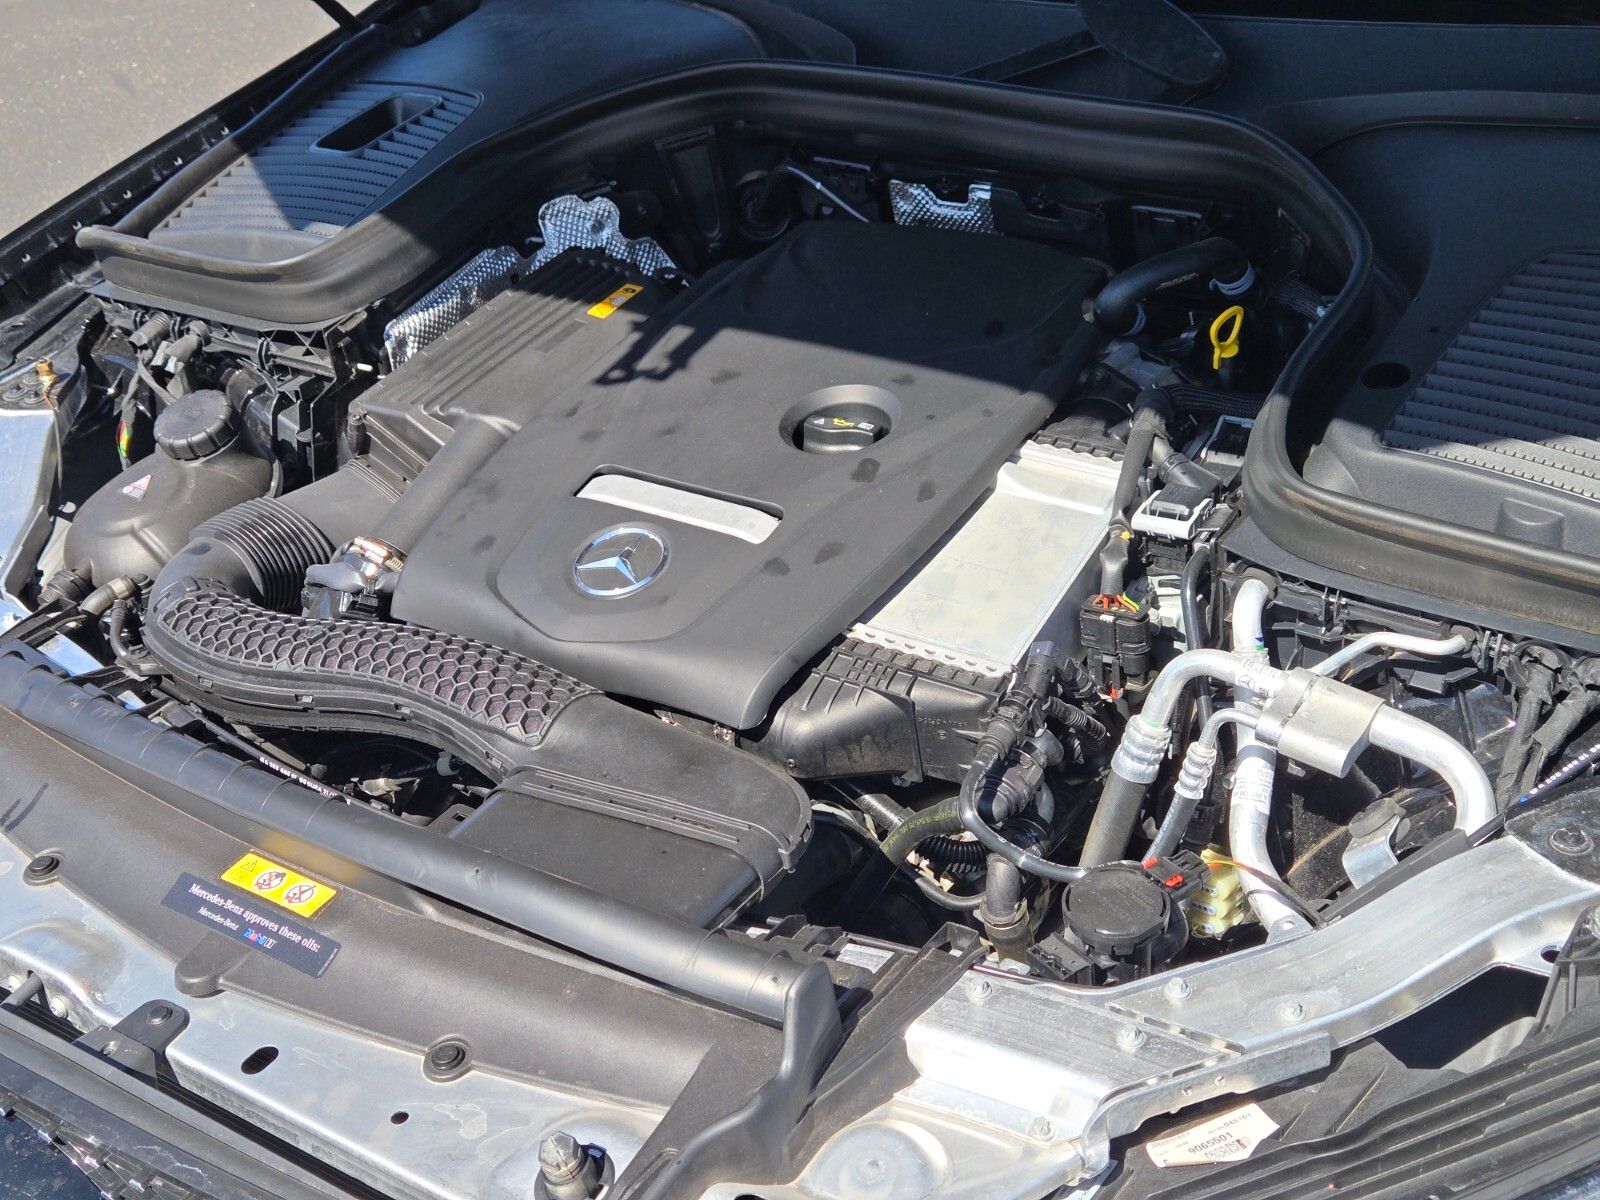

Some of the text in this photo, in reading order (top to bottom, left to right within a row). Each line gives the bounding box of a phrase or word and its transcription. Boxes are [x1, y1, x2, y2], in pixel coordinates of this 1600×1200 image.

[188, 883, 321, 953] Mercedes-Benz approves these oils:
[197, 906, 240, 931] Mercedes-Benz
[1188, 1131, 1233, 1154] 9065501
